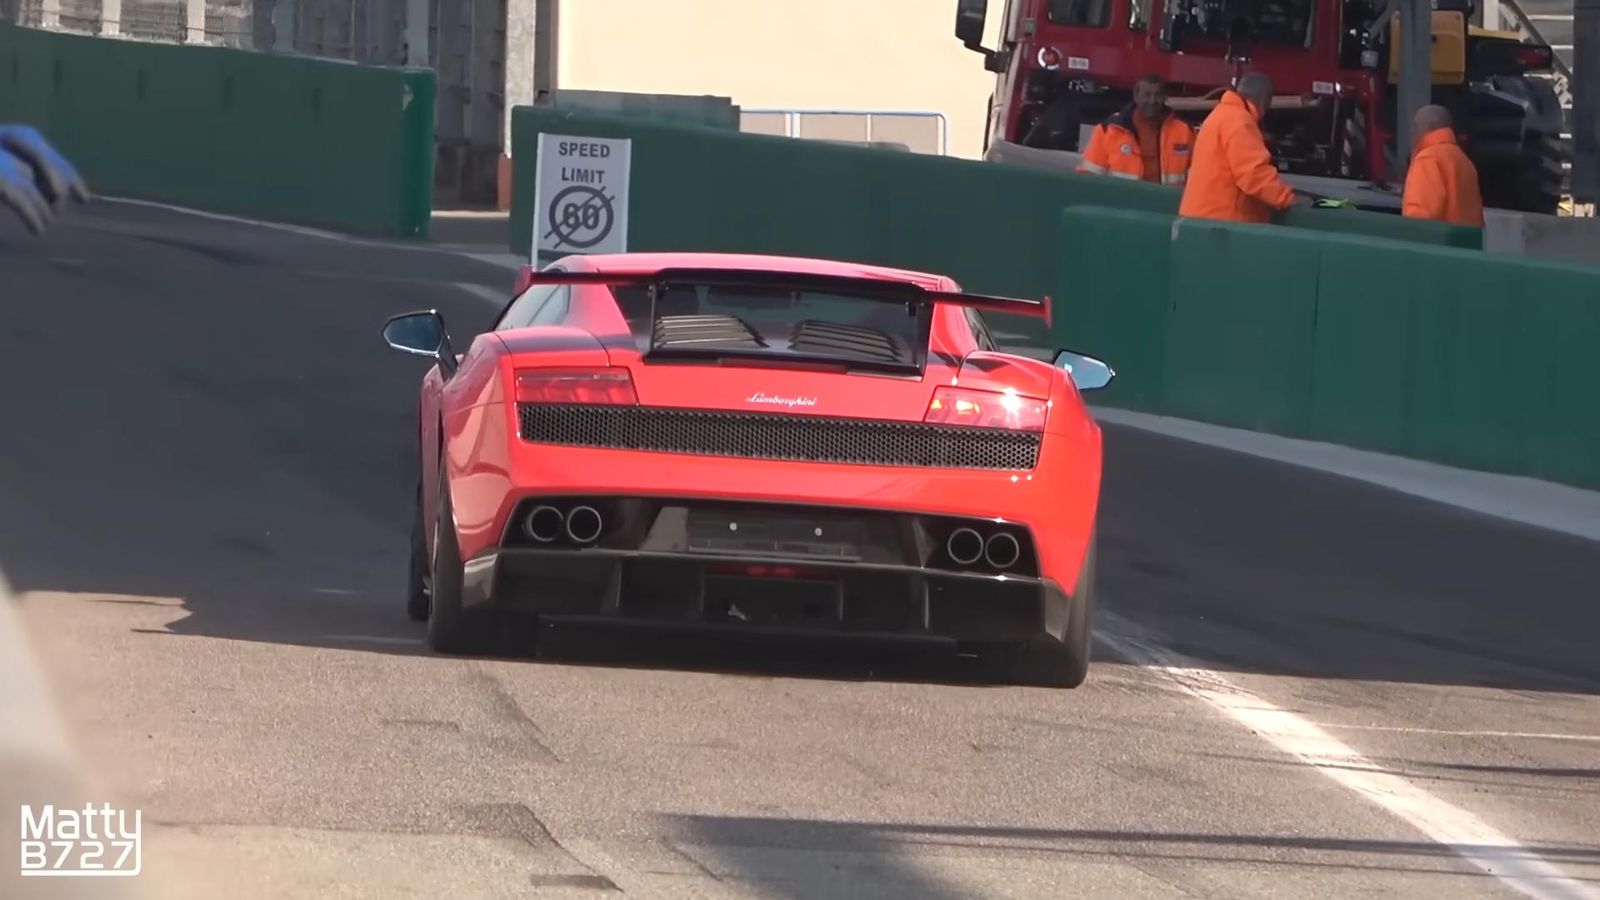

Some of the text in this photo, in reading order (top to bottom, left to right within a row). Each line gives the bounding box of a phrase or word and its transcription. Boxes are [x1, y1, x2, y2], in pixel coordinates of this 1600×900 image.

[558, 141, 611, 158] SPEED
[561, 166, 605, 184] LIMIT
[563, 202, 600, 230] 60
[745, 391, 818, 408] Lamborghini
